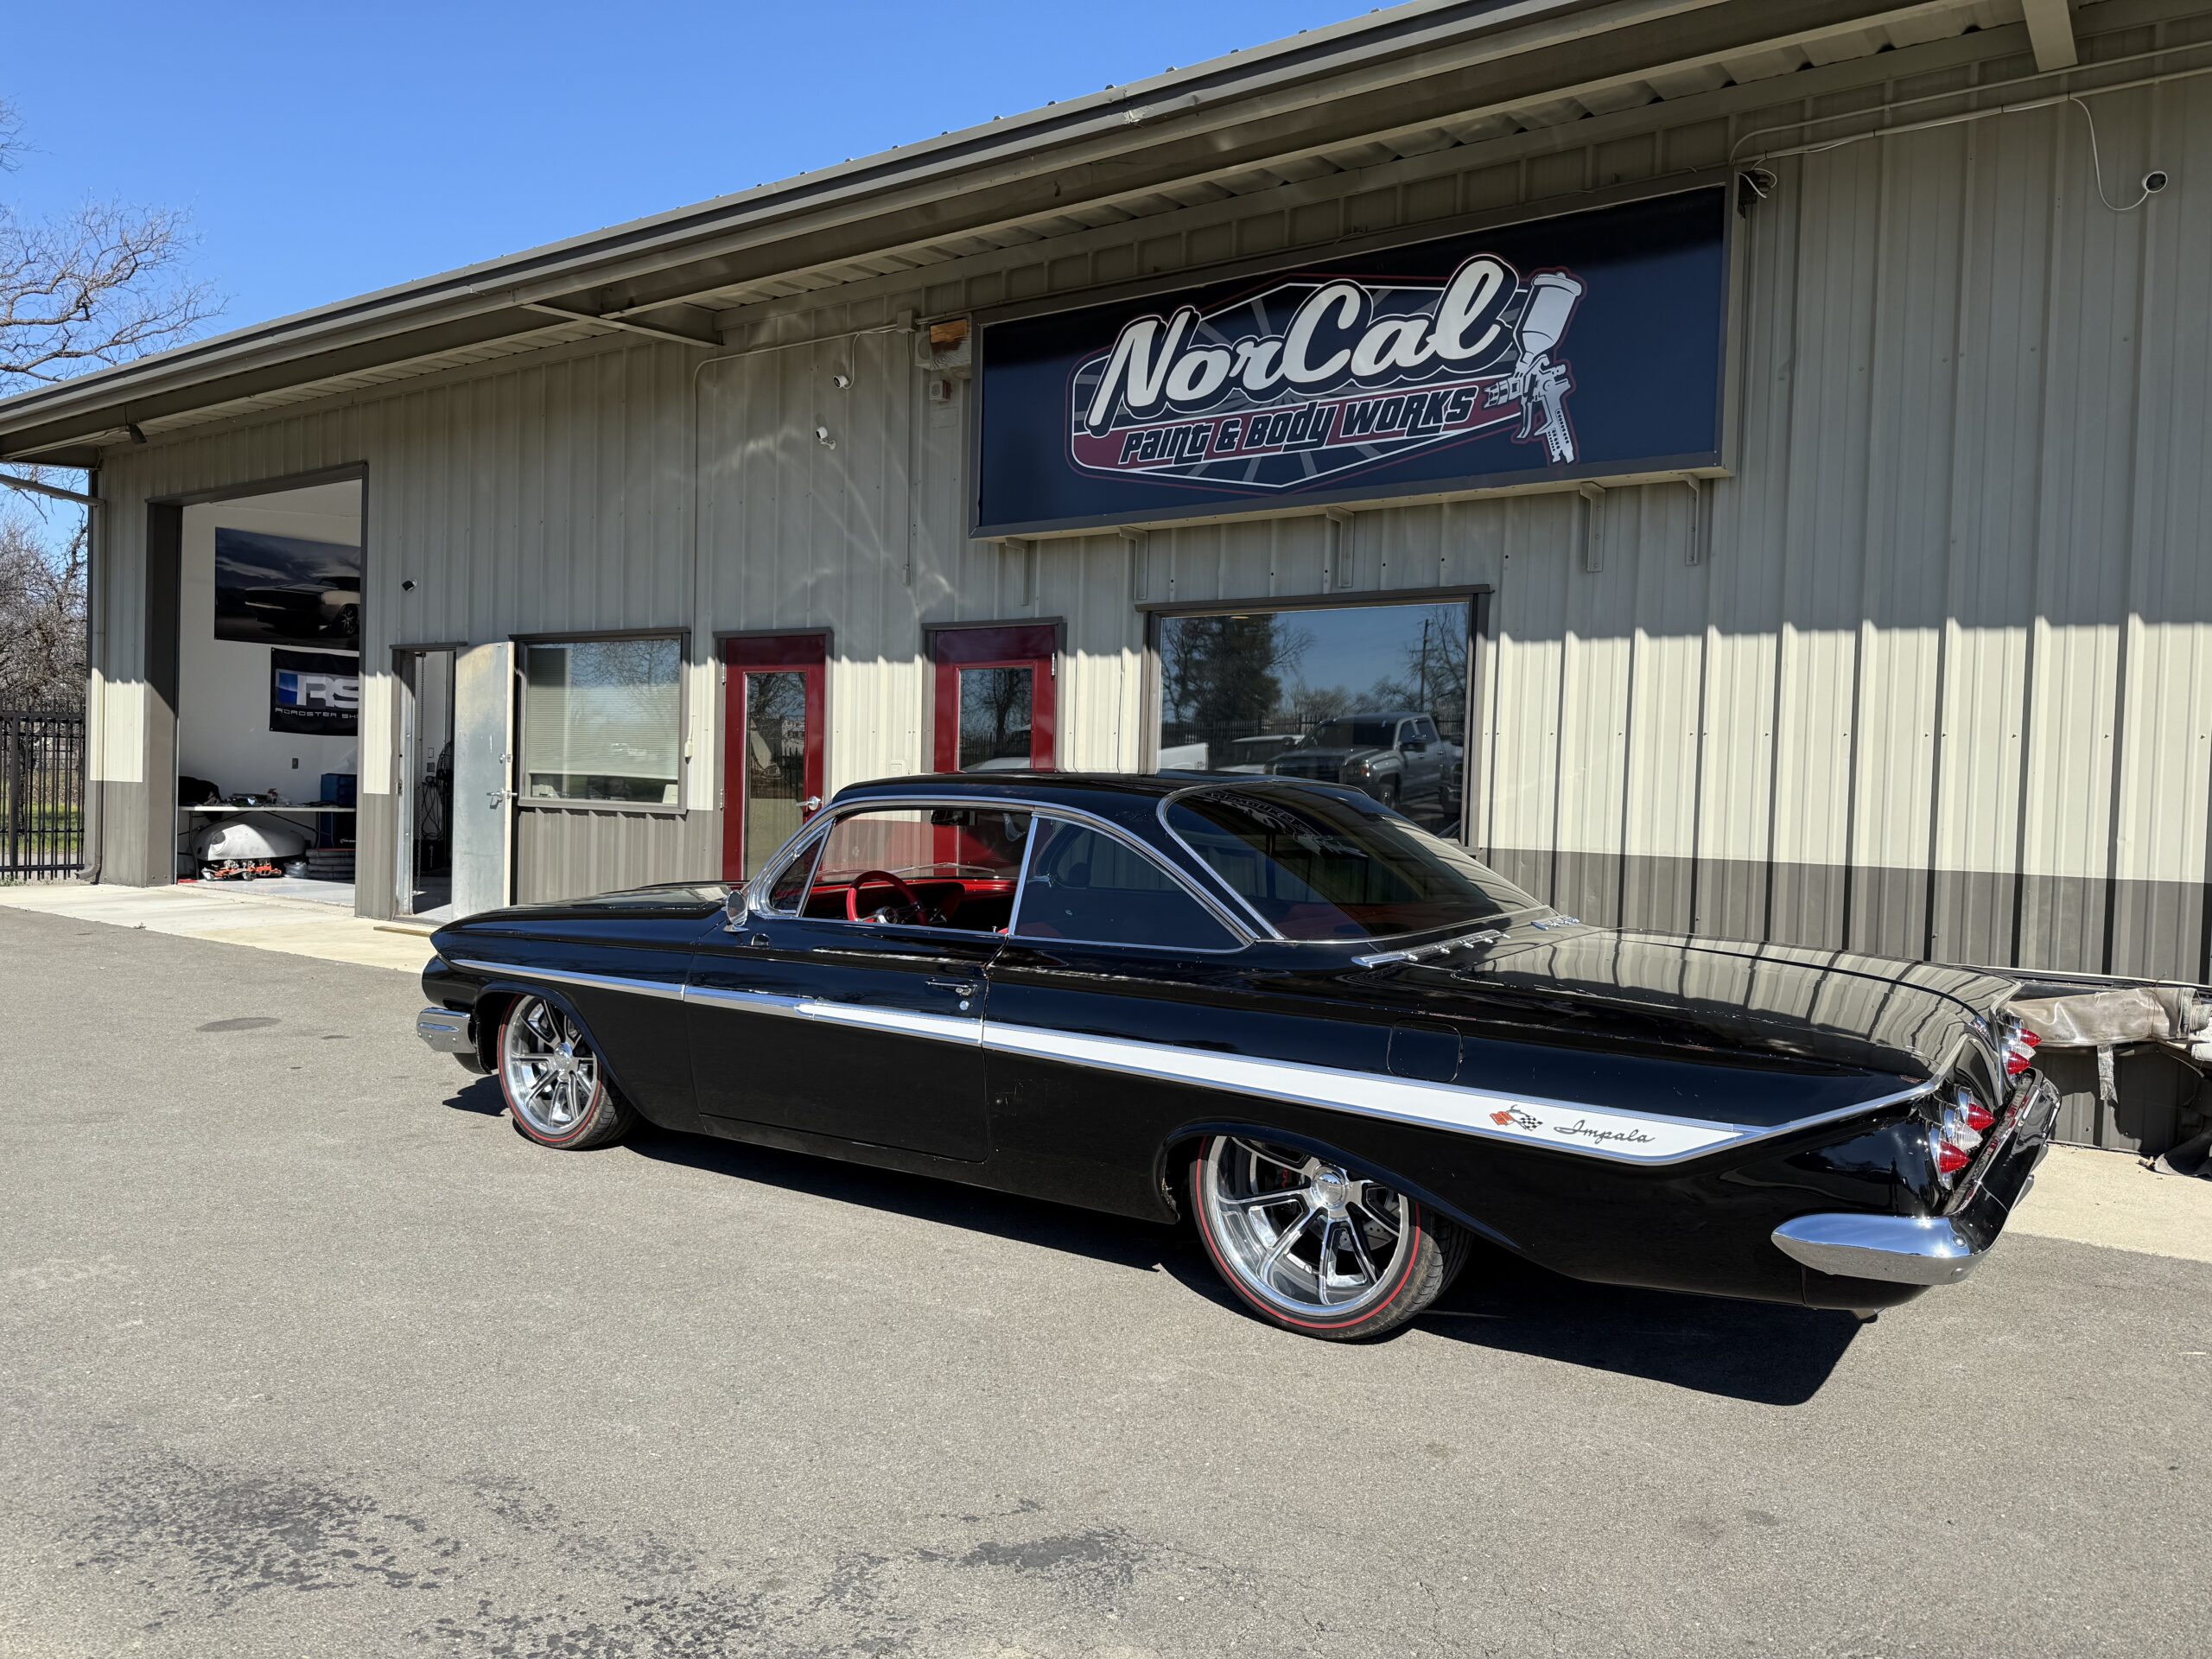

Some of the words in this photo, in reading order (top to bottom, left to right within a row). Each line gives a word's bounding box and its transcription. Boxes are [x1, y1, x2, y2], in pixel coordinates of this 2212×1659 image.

[1087, 257, 1509, 435] NorCal
[1214, 418, 1242, 453] &
[1339, 385, 1478, 437] WORKS
[296, 674, 359, 709] RS
[275, 707, 337, 717] ROADSTER
[1554, 1119, 1656, 1145] Impala
